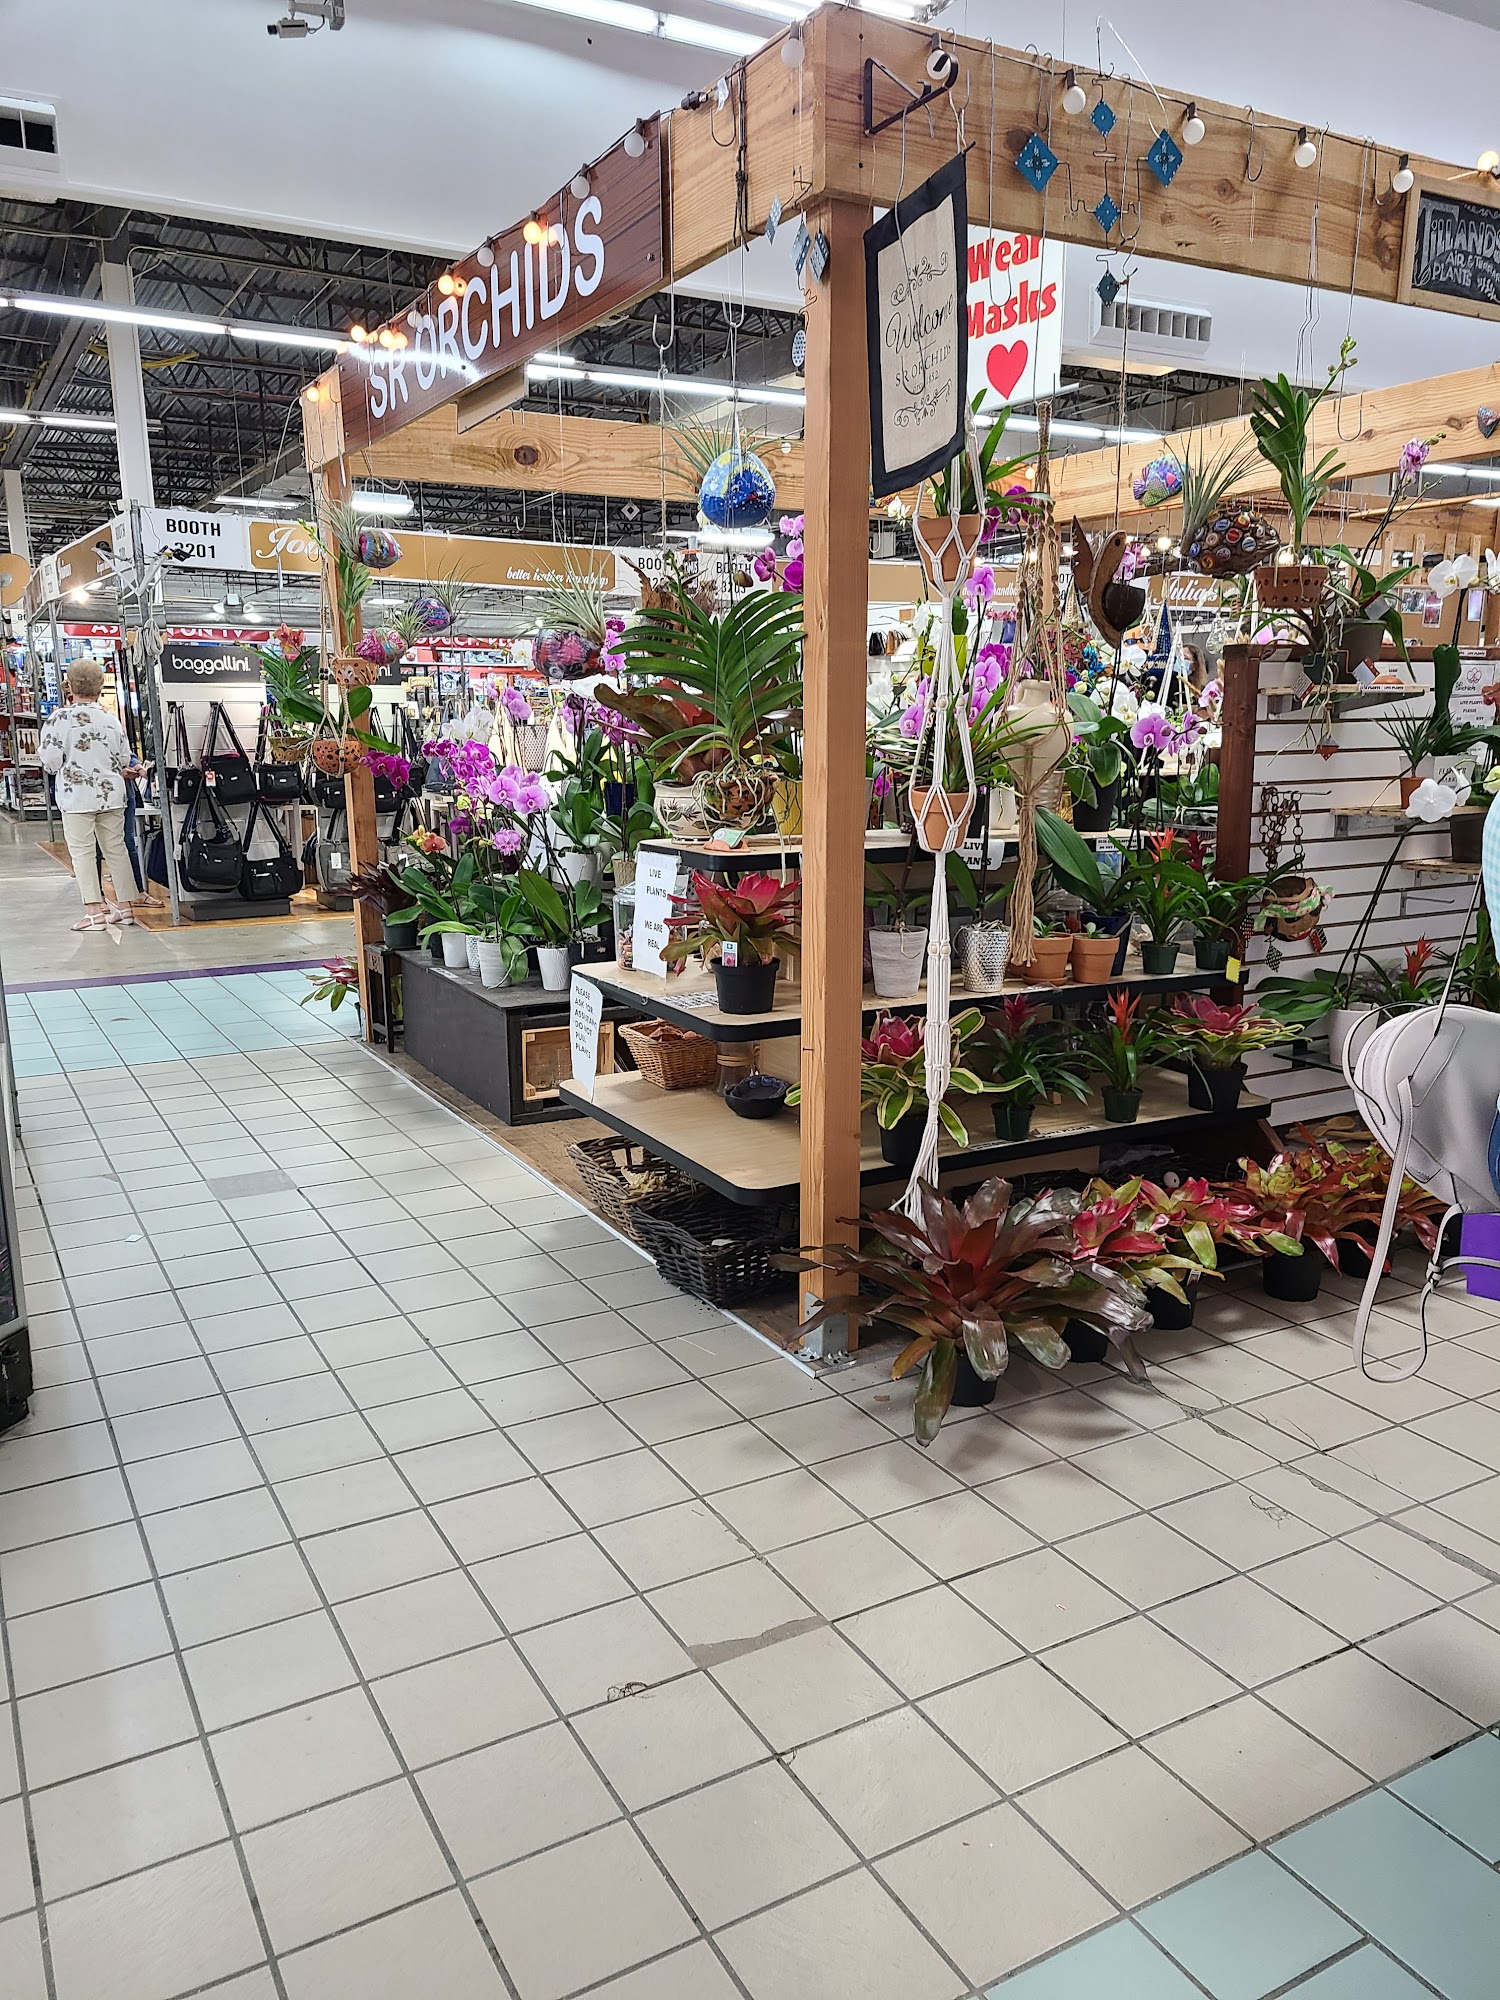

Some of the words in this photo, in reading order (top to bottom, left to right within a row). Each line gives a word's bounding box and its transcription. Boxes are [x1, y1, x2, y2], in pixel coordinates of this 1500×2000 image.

[967, 234, 1044, 284] Wear
[1432, 262, 1472, 288] PLANTS
[370, 347, 409, 418] SR
[415, 195, 605, 391] ORCHIDS
[967, 280, 1057, 339] Masks
[885, 294, 954, 354] Welcome
[166, 518, 221, 537] BOOTH
[506, 567, 531, 580] better
[649, 868, 662, 879] LIVE
[646, 885, 667, 898] PLANTS
[644, 919, 653, 930] WE
[653, 922, 663, 933] ARE
[647, 938, 660, 950] REAL
[575, 985, 591, 1000] PLEASE
[574, 997, 584, 1009] ASK
[574, 1020, 584, 1030] DO
